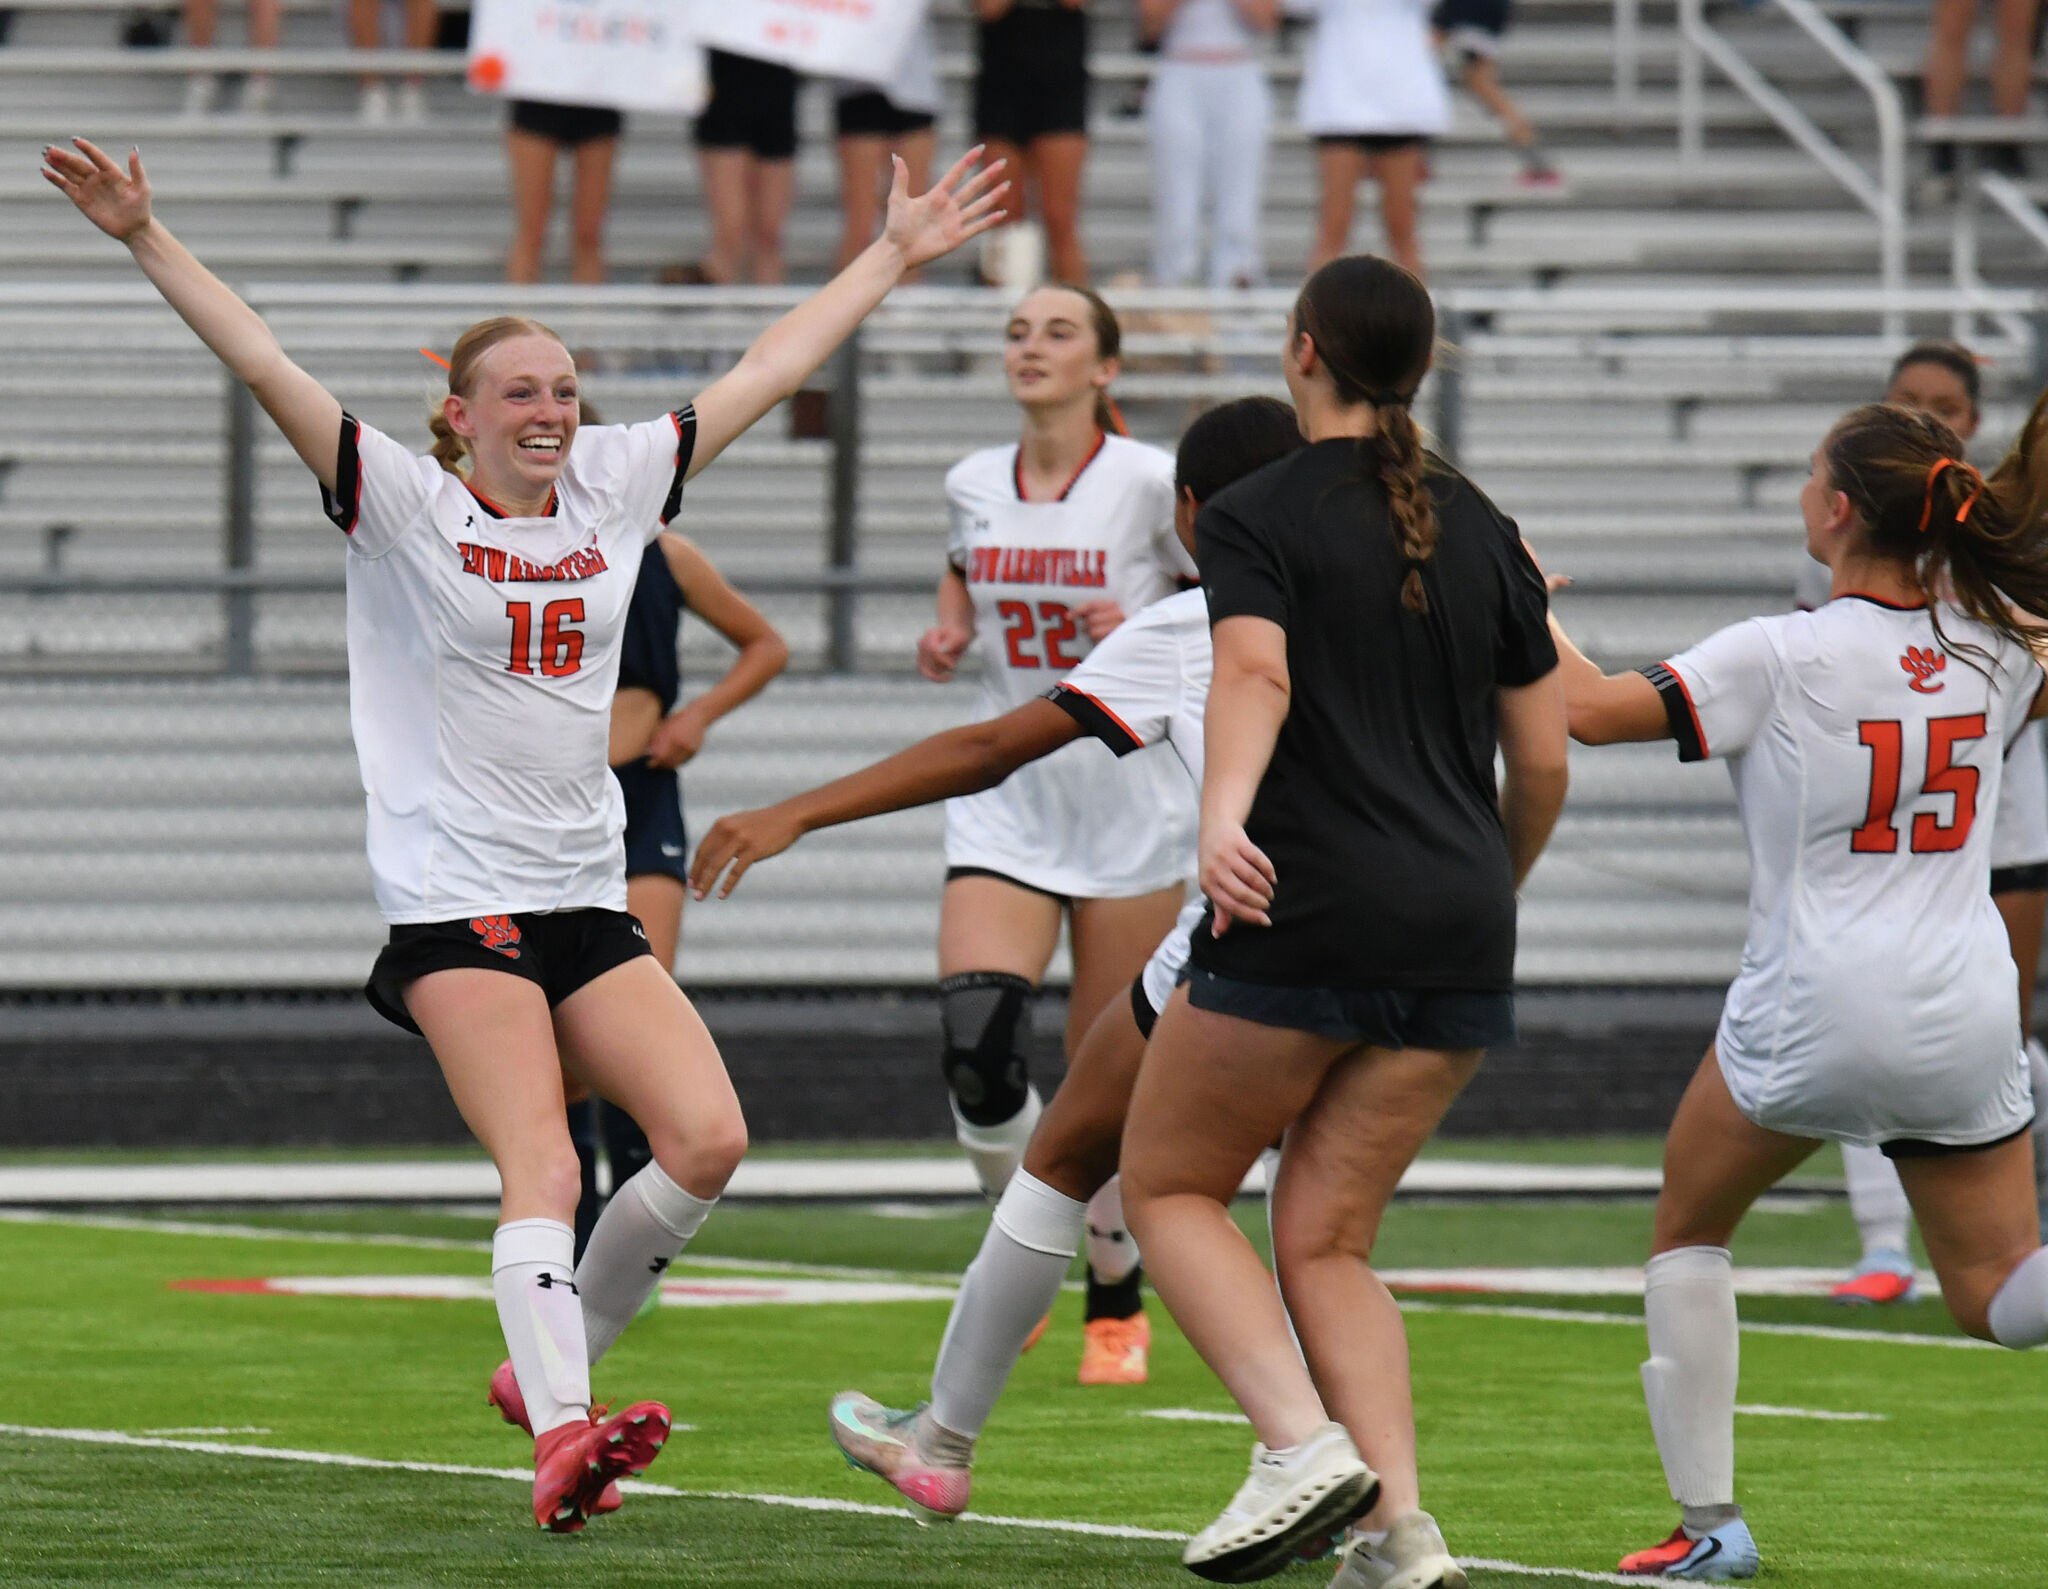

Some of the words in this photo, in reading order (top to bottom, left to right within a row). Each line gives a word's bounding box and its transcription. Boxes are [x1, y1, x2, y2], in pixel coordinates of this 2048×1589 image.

[504, 597, 585, 677] 16
[998, 600, 1081, 668] 22
[1850, 712, 1988, 853] 15
